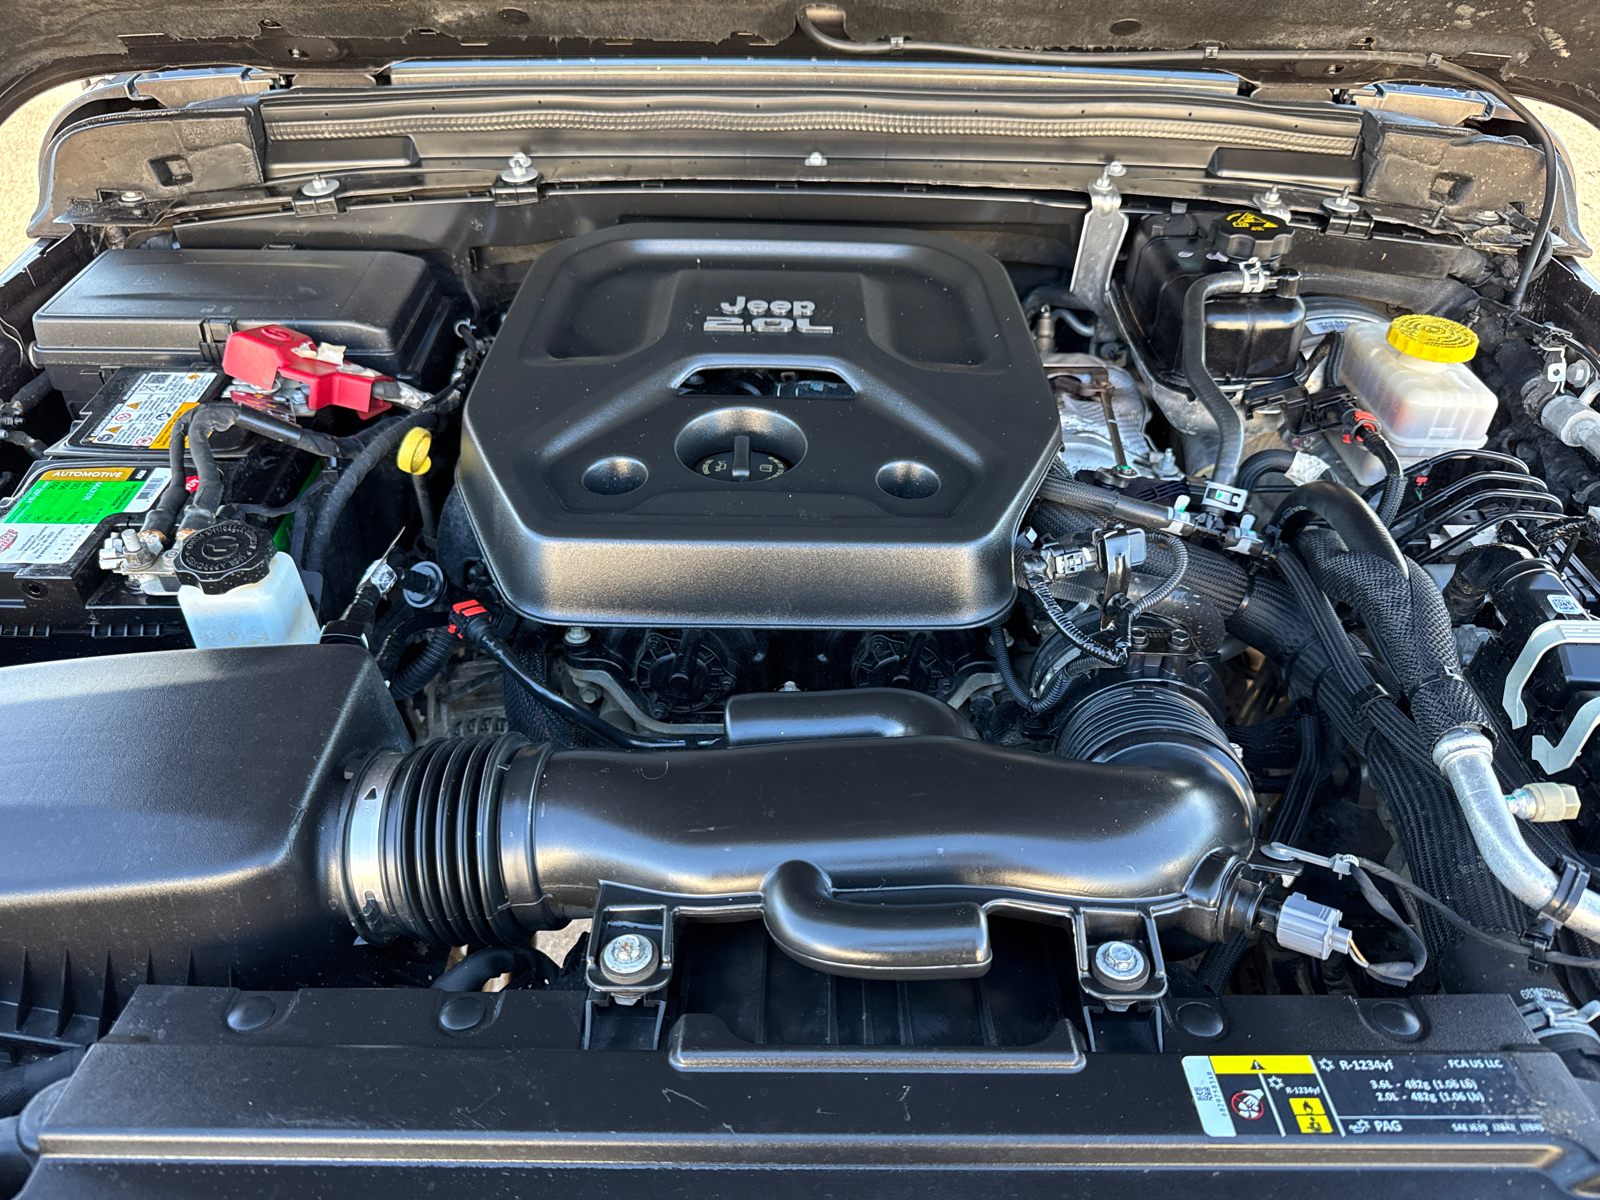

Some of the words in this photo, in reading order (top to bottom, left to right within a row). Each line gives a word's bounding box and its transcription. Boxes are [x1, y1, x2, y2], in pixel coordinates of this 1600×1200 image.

[720, 296, 816, 318] Jeep
[703, 316, 833, 334] 2.0L
[1339, 1058, 1394, 1072] R-1234yf
[1448, 1059, 1469, 1069] FCA
[1470, 1059, 1483, 1069] US
[1484, 1059, 1503, 1069] LLC
[1285, 1086, 1321, 1096] R-1234yf
[1369, 1079, 1393, 1090] 3.6L
[1404, 1079, 1431, 1091] 482g
[1432, 1078, 1459, 1091] (1.06
[1206, 1071, 1228, 1117] 68297583AB
[1375, 1091, 1399, 1102] 2.0L
[1411, 1091, 1438, 1104] 482g
[1438, 1090, 1466, 1103] (1.06
[1374, 1120, 1403, 1133] PAG
[1451, 1122, 1469, 1132] SAE
